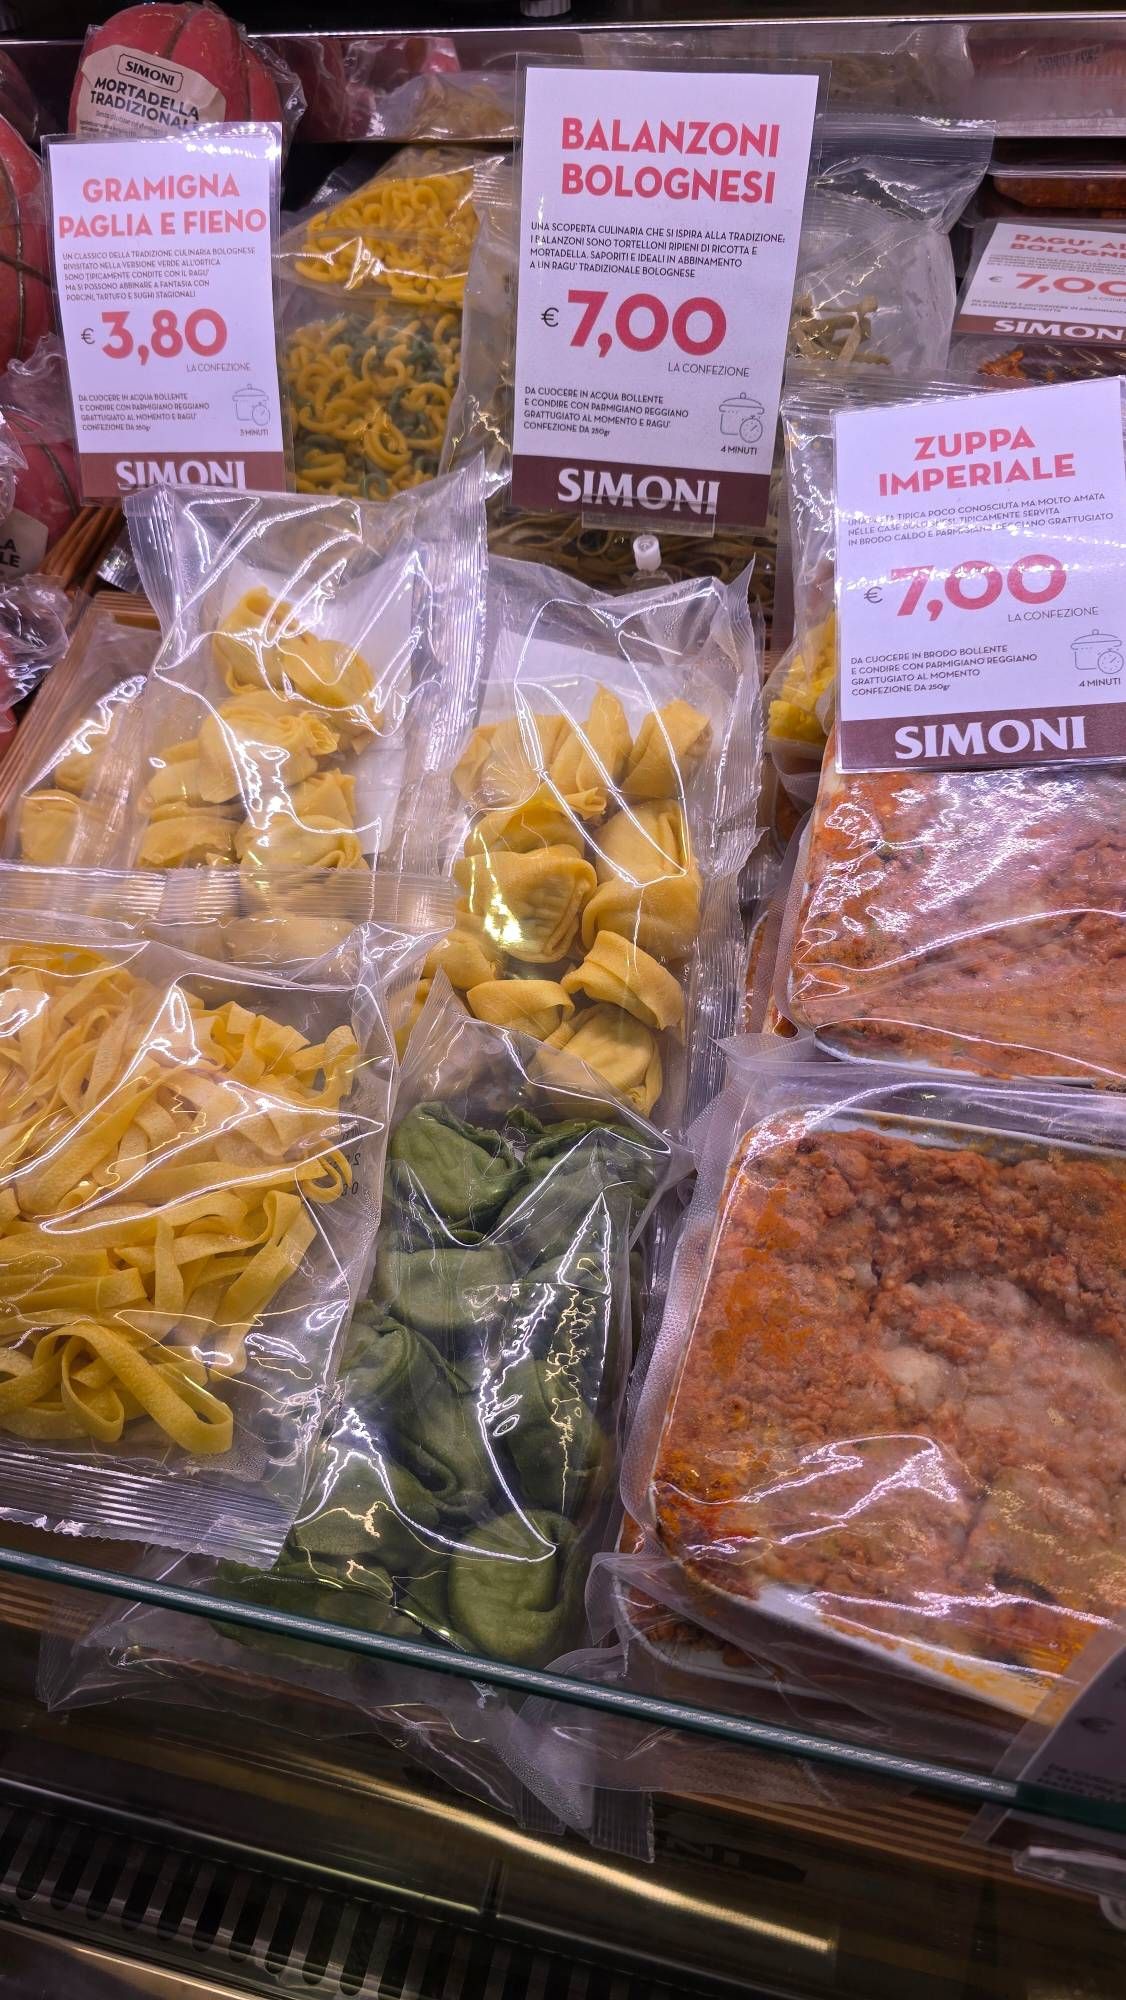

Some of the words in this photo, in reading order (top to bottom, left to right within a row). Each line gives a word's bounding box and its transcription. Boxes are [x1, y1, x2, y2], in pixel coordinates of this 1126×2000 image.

[125, 61, 175, 86] SIMONI
[94, 77, 200, 121] MORTADELLA
[90, 91, 198, 131] TRADIZIONAL
[561, 117, 780, 158] BALANZONI
[83, 173, 240, 203] GRAMIGNA
[561, 163, 776, 204] BOLOGNESI
[59, 213, 152, 238] PAGLIA
[161, 212, 175, 235] E
[184, 208, 267, 234] FIENO
[531, 222, 550, 231] UNA
[552, 223, 596, 233] SCOPERTA
[598, 225, 644, 236] CULINARIA
[646, 227, 664, 237] CHE
[666, 228, 674, 237] SI
[675, 229, 702, 239] ISPIRA
[704, 230, 727, 240] ALLA
[535, 235, 584, 245] BALANZONI
[586, 237, 612, 247] SONO
[613, 239, 667, 250] TORTELLONI
[669, 242, 699, 252] RIPIENI
[701, 244, 710, 253] DI
[712, 244, 750, 255] RICOTTA
[752, 247, 758, 255] E
[1014, 234, 1093, 246] RAGU'
[63, 252, 72, 260] UN
[75, 252, 107, 260] CLASSICO
[131, 249, 172, 257] TRADIZIONE
[174, 248, 211, 257] CULINARIA
[213, 247, 256, 256] BOLOGNESE
[590, 250, 628, 260] SAPORITI
[631, 253, 635, 261] E
[638, 253, 665, 263] IDEALI
[666, 255, 676, 264] IN
[678, 256, 742, 268] ABBINAMENTO
[64, 262, 98, 270] RIVISITATO
[100, 261, 121, 269] NELLA
[122, 260, 155, 268] VERSIONE
[530, 261, 535, 269] A
[538, 262, 550, 270] UN
[552, 262, 578, 271] RAGU'
[580, 263, 640, 274] TRADIZIONALE
[643, 267, 695, 278] BOLOGNESE
[65, 273, 84, 281] SONO
[86, 272, 130, 280] TIPICAMENTE
[132, 271, 162, 279] CONDITE
[164, 270, 180, 278] CON
[85, 282, 117, 290] POSSONO
[120, 281, 152, 289] ABBINARE
[160, 280, 192, 288] FANTASIA
[194, 279, 209, 287] CON
[96, 292, 126, 301] TARTUFO
[134, 291, 155, 299] SUGHI
[156, 290, 196, 299] STAGIONALI
[540, 307, 559, 328] €
[567, 289, 727, 358] 7,00
[993, 319, 1126, 341] SIMON
[80, 328, 95, 344] €
[101, 308, 227, 366] 3,80
[187, 364, 198, 373] LA
[198, 362, 250, 372] CONFEZIONE
[668, 362, 680, 373] LA
[682, 363, 750, 377] CONFEZIONE
[130, 393, 153, 401] ACQUA
[154, 393, 188, 401] BOLLENTE
[525, 386, 536, 395] DA
[538, 387, 578, 398] CUOCERE
[580, 390, 588, 398] IN
[590, 392, 619, 400] ACQUA
[621, 393, 664, 404] BOLLENTE
[132, 403, 173, 411] PARMIGIANO
[175, 402, 210, 410] REGGIANO
[525, 398, 529, 406] E
[531, 399, 568, 409] CONDIRE
[570, 401, 589, 410] CON
[591, 403, 643, 414] PARMIGIANO
[645, 406, 689, 418] REGGIANO
[136, 413, 171, 421] MOMENTO
[524, 410, 580, 421] GRATTUGIATO
[582, 414, 592, 422] AL
[594, 415, 637, 426] MOMENTO
[640, 418, 644, 426] E
[646, 419, 671, 428] RAGU'
[82, 423, 125, 431] CONFEZIONE
[126, 423, 135, 431] DA
[245, 428, 269, 437] MINUTI
[523, 421, 577, 432] CONFEZIONE
[579, 425, 590, 433] DA
[591, 427, 610, 437] 250gr
[720, 445, 726, 453] 4
[727, 446, 758, 456] MINUTI
[914, 426, 1036, 461] ZUPPA
[116, 460, 247, 490] SIMONI
[879, 453, 1076, 496] IMPERIALE
[557, 468, 721, 515] SIMONI
[898, 511, 926, 520] TIPICA
[928, 508, 955, 517] POCO
[958, 501, 1019, 514] CONOSCIUTA
[1021, 499, 1036, 508] MA
[1038, 496, 1071, 506] MOLTO
[1073, 493, 1105, 502] AMATA
[848, 526, 878, 536] NELLE
[878, 523, 903, 533] CASE
[960, 511, 1020, 523] TIPICAMENTE
[1023, 507, 1060, 518] SERVITA
[848, 539, 857, 547] IN
[860, 535, 892, 545] BRODO
[894, 531, 926, 541] CALDO
[1047, 513, 1114, 524] GRATTUGIATO
[864, 586, 883, 604] €
[890, 554, 1067, 621] 7,00
[1007, 613, 1021, 623] LA
[1023, 607, 1099, 621] CONFEZIONE
[851, 657, 863, 665] DA
[865, 653, 910, 664] CUOCERE
[912, 652, 921, 660] IN
[923, 649, 957, 659] BRODO
[960, 645, 1008, 656] BOLLENTE
[859, 664, 900, 674] CONDIRE
[902, 662, 924, 671] CON
[925, 657, 985, 669] PARMIGIANO
[987, 654, 1038, 665] REGGIANO
[851, 674, 915, 686] GRATTUGIATO
[917, 673, 928, 681] AL
[930, 669, 980, 679] MOMENTO
[1079, 679, 1086, 688] 4
[1087, 677, 1121, 687] MINUTI
[851, 685, 912, 696] CONFEZIONE
[914, 684, 927, 692] DA
[928, 684, 951, 692] 250gr
[894, 715, 1088, 760] SIMONI
